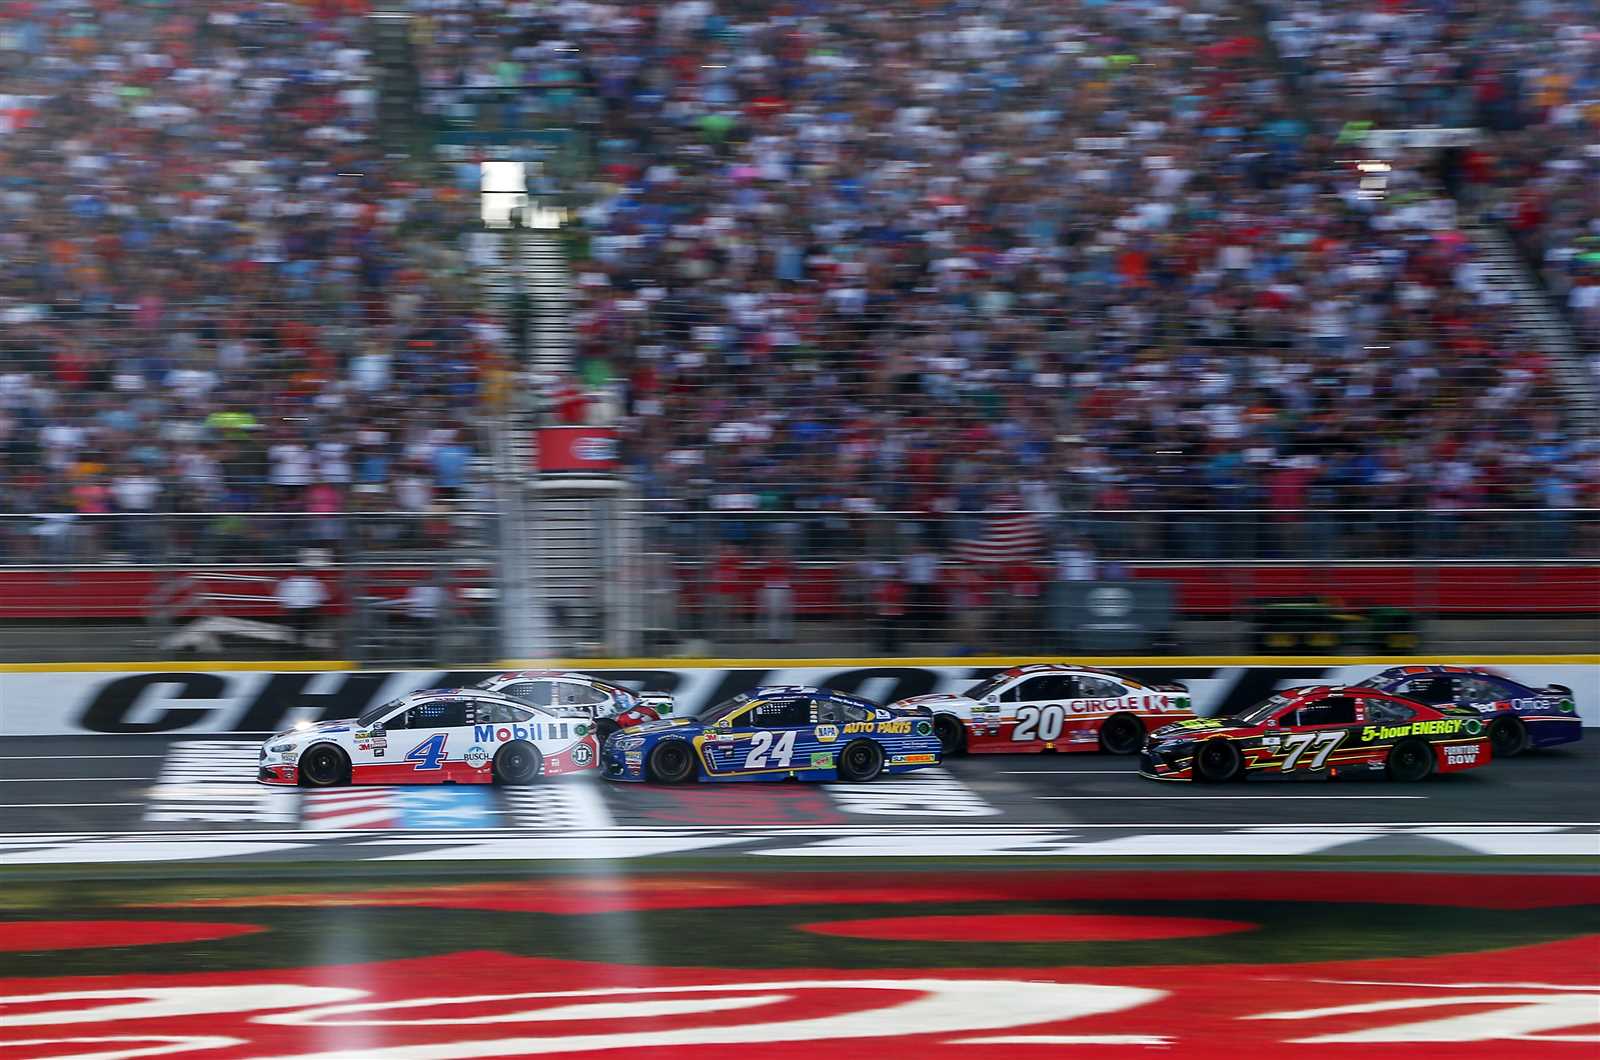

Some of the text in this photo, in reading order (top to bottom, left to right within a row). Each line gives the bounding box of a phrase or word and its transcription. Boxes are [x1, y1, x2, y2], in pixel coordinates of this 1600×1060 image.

[1071, 697, 1137, 712] CIRCLE
[843, 721, 912, 734] AUTO PARTS
[1011, 705, 1064, 741] 20
[1412, 720, 1462, 735] ENERGY
[474, 723, 542, 743] Mobil
[404, 733, 448, 771] 4
[463, 752, 489, 761] BUSCH
[744, 731, 796, 769] 24
[1281, 732, 1348, 773] 77
[1448, 754, 1477, 764] ROW
